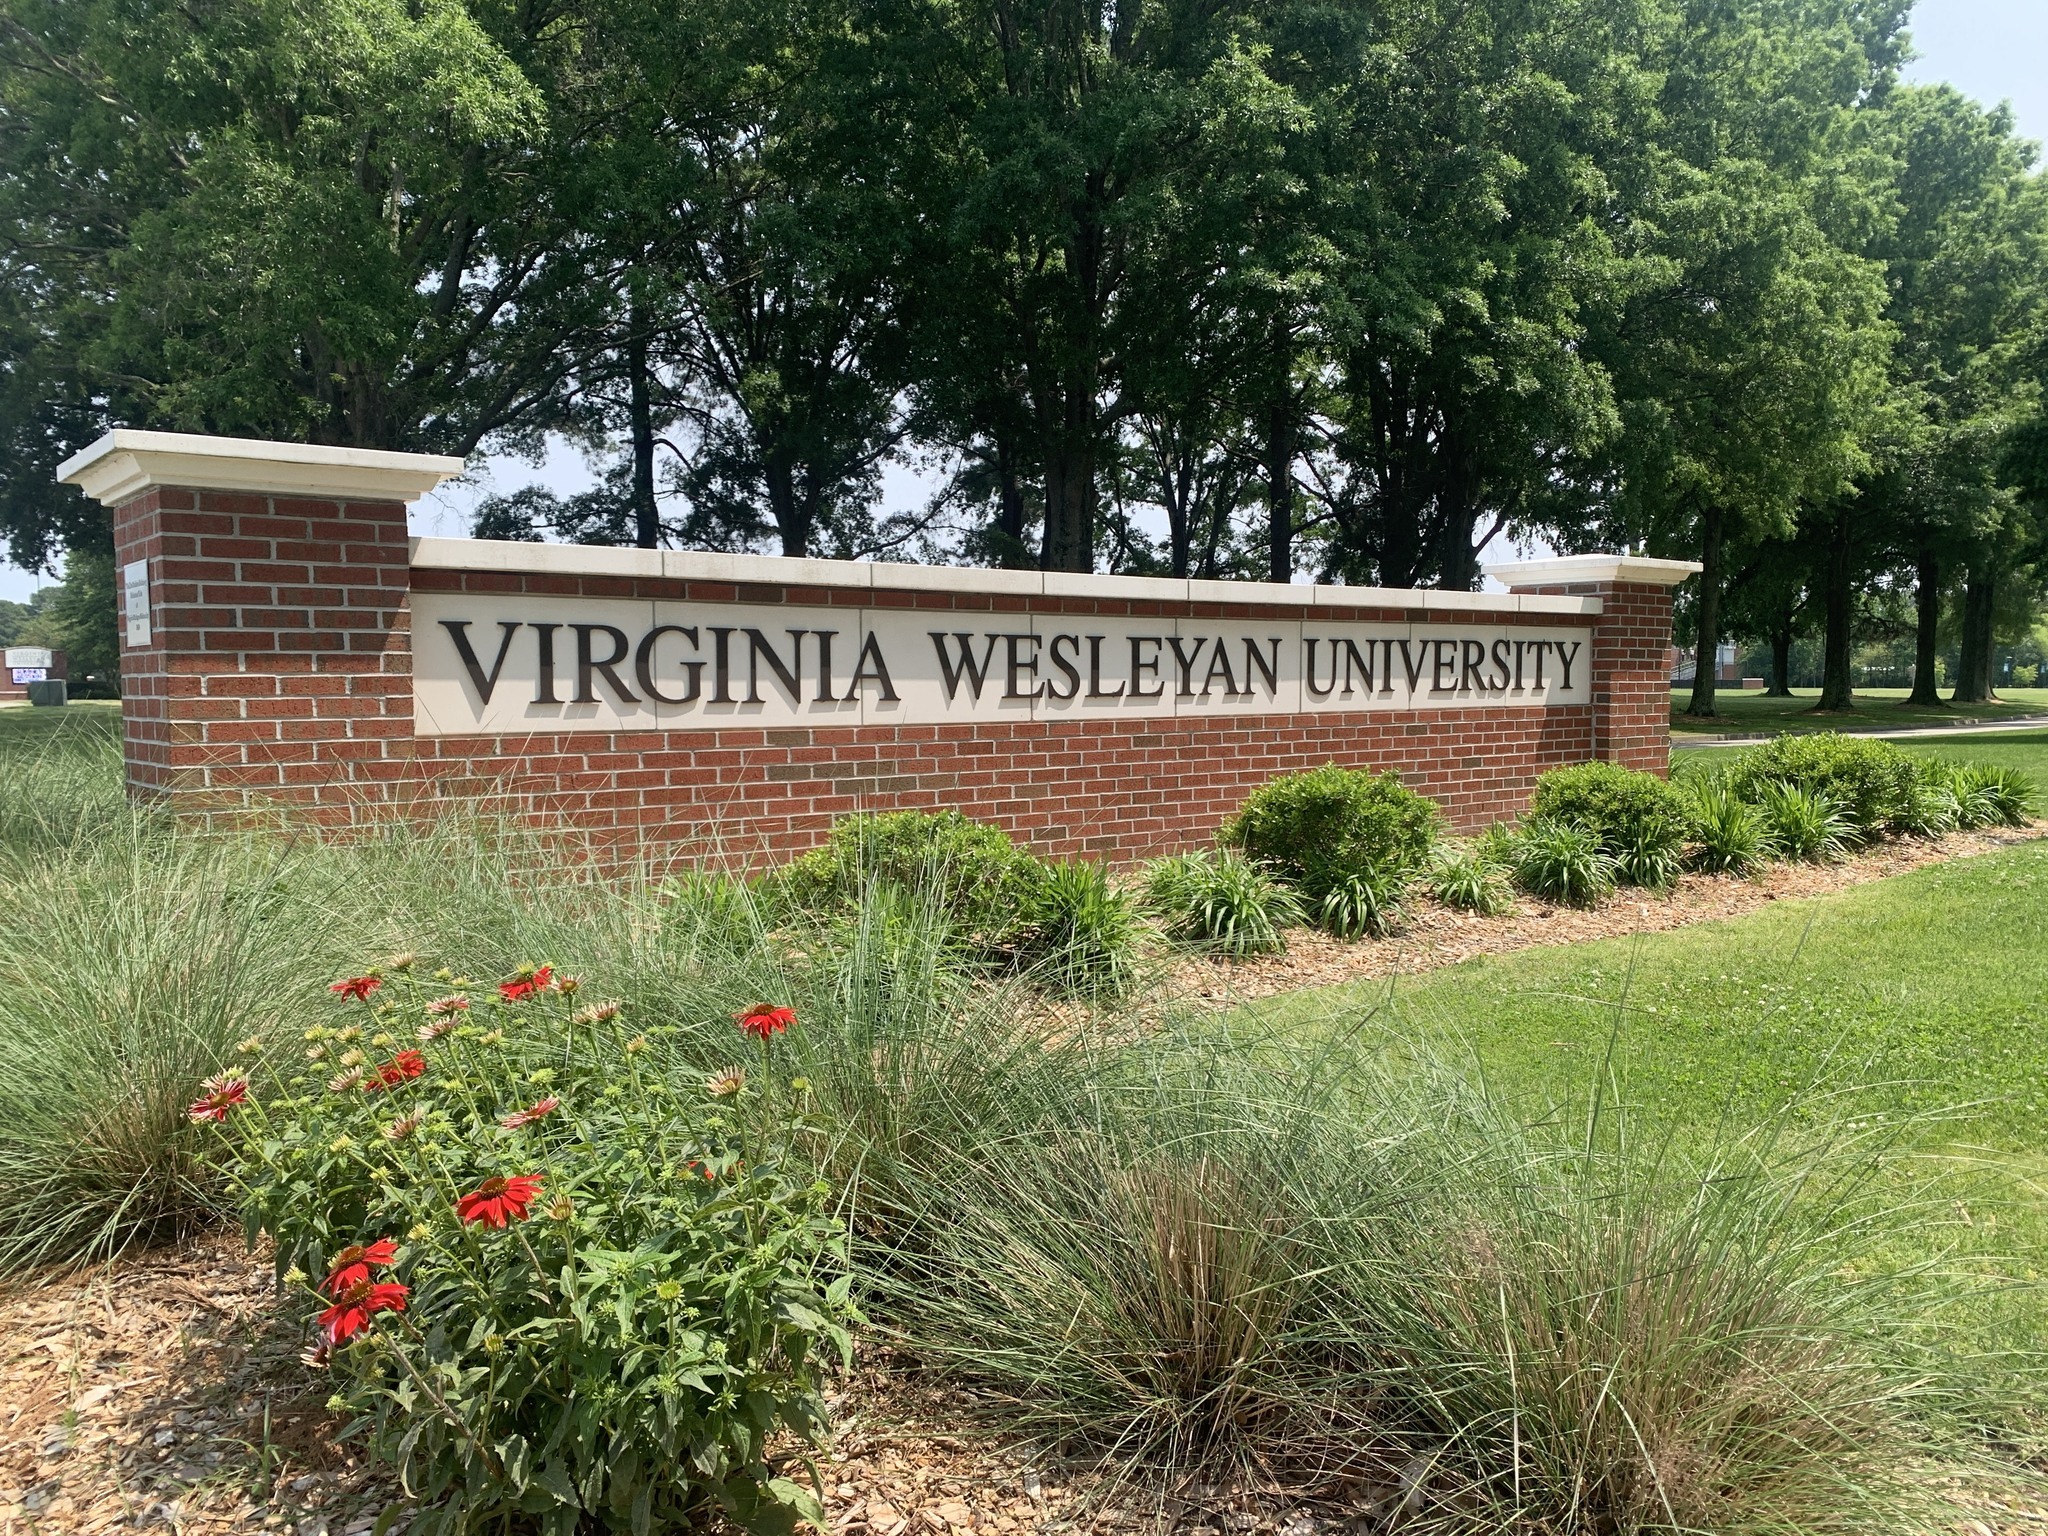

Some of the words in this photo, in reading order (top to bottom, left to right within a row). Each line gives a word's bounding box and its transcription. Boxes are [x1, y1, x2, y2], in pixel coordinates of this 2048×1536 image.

[438, 620, 902, 705] VIRGINIA
[927, 632, 1283, 701] WESLEYAN
[1303, 637, 1582, 696] UNIVERSITY
